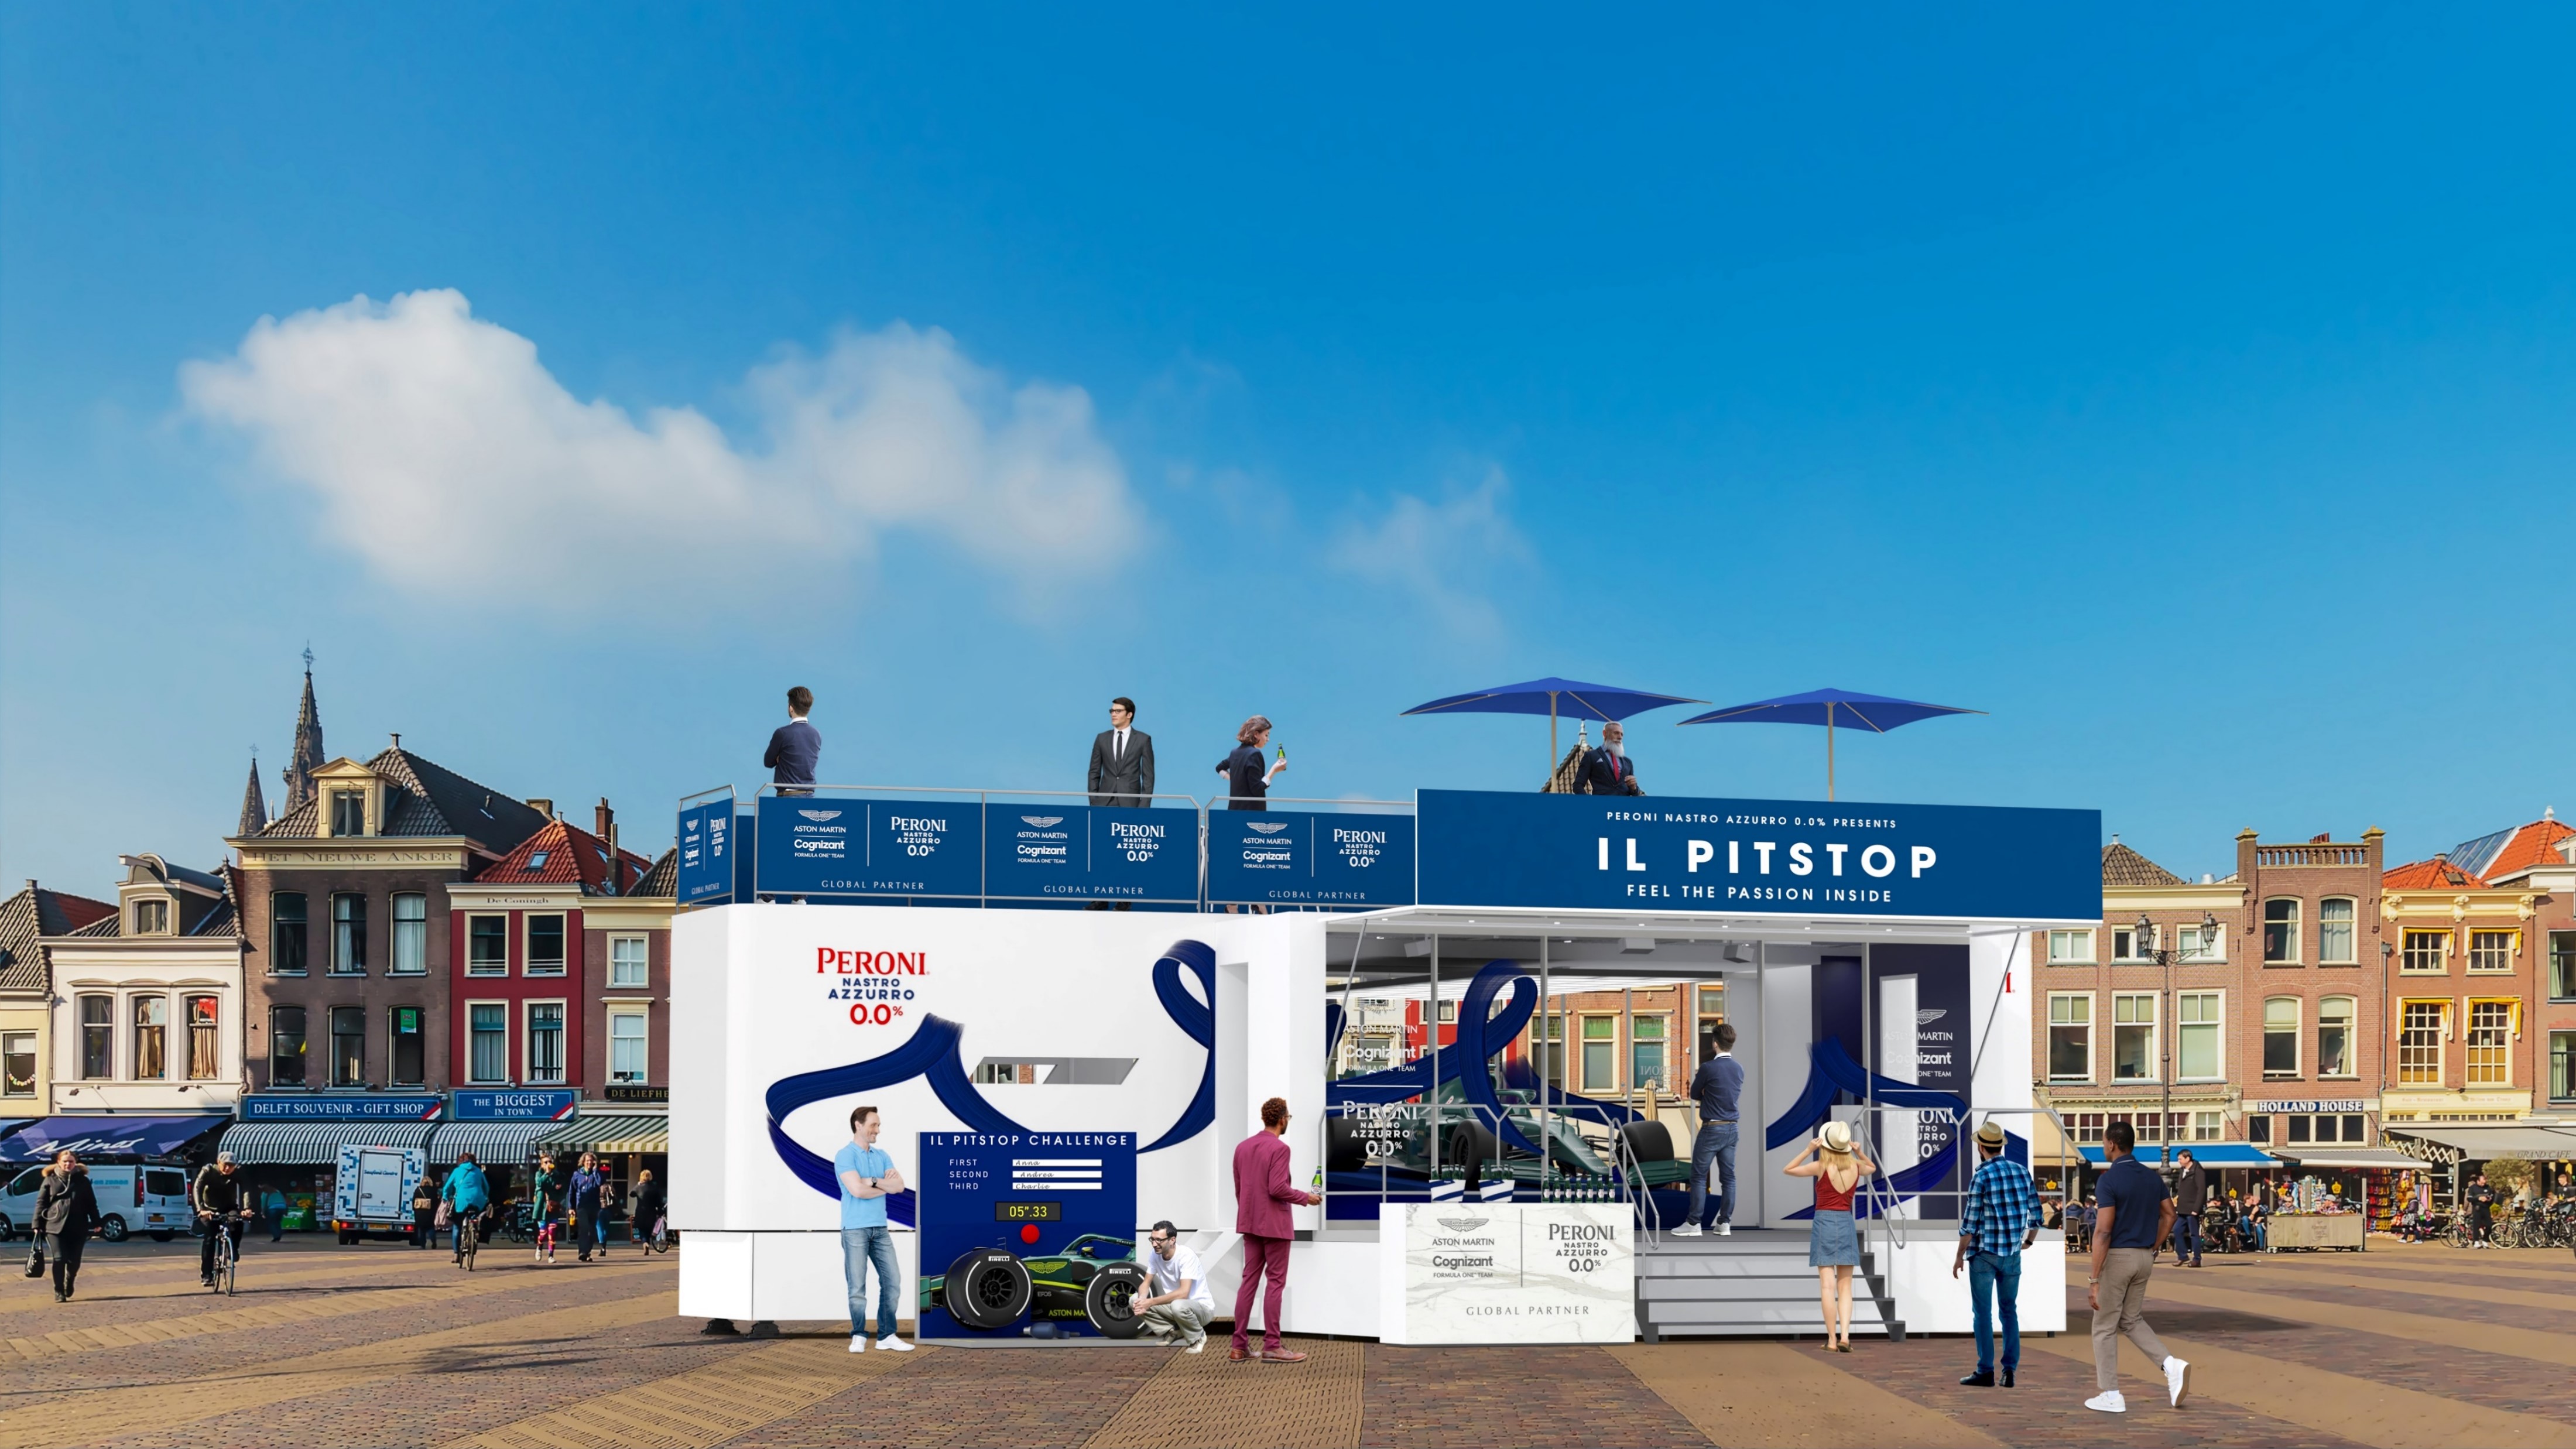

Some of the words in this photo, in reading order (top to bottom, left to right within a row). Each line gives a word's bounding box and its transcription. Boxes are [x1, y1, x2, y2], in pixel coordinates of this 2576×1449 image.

[710, 817, 726, 833] PERONI
[891, 817, 947, 831] PERONI
[1607, 812, 1657, 821] PERONI
[1666, 814, 1718, 823] NASTRO
[1726, 816, 1787, 824] AZZURRO
[1794, 817, 1825, 826] 0.0%
[1834, 818, 1896, 828] PRESENTS
[1111, 823, 1165, 837] PERONI
[1334, 829, 1386, 843] PERONI
[794, 839, 845, 851] Cognizant
[907, 845, 934, 857] 0.0%
[1017, 845, 1066, 857] Cognizant
[254, 852, 292, 862] HET
[302, 852, 376, 862] NIEUWE
[387, 852, 453, 861] ANKER
[1127, 851, 1153, 862] 0.0%
[1243, 851, 1290, 862] Cognizant
[1349, 856, 1375, 867] 0.0%
[1598, 837, 1646, 871] IL
[1688, 840, 1936, 878] PITSTOP
[691, 886, 704, 895] GLOBAL
[705, 882, 720, 892] PARTNER
[821, 881, 866, 889] GLOBAL
[873, 882, 924, 890] PARTNER
[1044, 885, 1087, 893] GLOBAL
[1094, 886, 1143, 895] PARTNER
[1627, 884, 1670, 897] FEEL
[1682, 885, 1715, 898] THE
[1728, 887, 1813, 900] PASSION
[1826, 889, 1891, 902] INSIDE
[817, 947, 927, 975] PERONI
[842, 978, 900, 987] NASTRO
[828, 989, 914, 1000] AZZURRO
[849, 1003, 903, 1025] 0.0%
[1342, 1025, 1376, 1033] ASTON
[1379, 1025, 1417, 1033] MARTIN
[1918, 1032, 1952, 1040] MARTIN
[1344, 1044, 1416, 1061] Cognizant
[495, 1095, 554, 1107] BIGGEST
[2258, 1101, 2316, 1112] HOLLAND
[2319, 1101, 2362, 1111] HOUSE
[254, 1104, 291, 1114] DELFT
[294, 1104, 352, 1114] SOUVENIR
[364, 1104, 391, 1114] GIFT
[394, 1104, 424, 1114] SHOP
[1342, 1100, 1417, 1120] PERONI
[931, 1135, 943, 1145] IL
[954, 1135, 1019, 1145] PITSTOP
[1029, 1135, 1128, 1145] CHALLENGE
[1549, 1224, 1615, 1240] PERONI
[1433, 1255, 1493, 1270] Cognizant
[1569, 1258, 1601, 1272] 0.0%
[1466, 1307, 1520, 1316] GLOBAL
[1529, 1306, 1590, 1315] PARTNER
